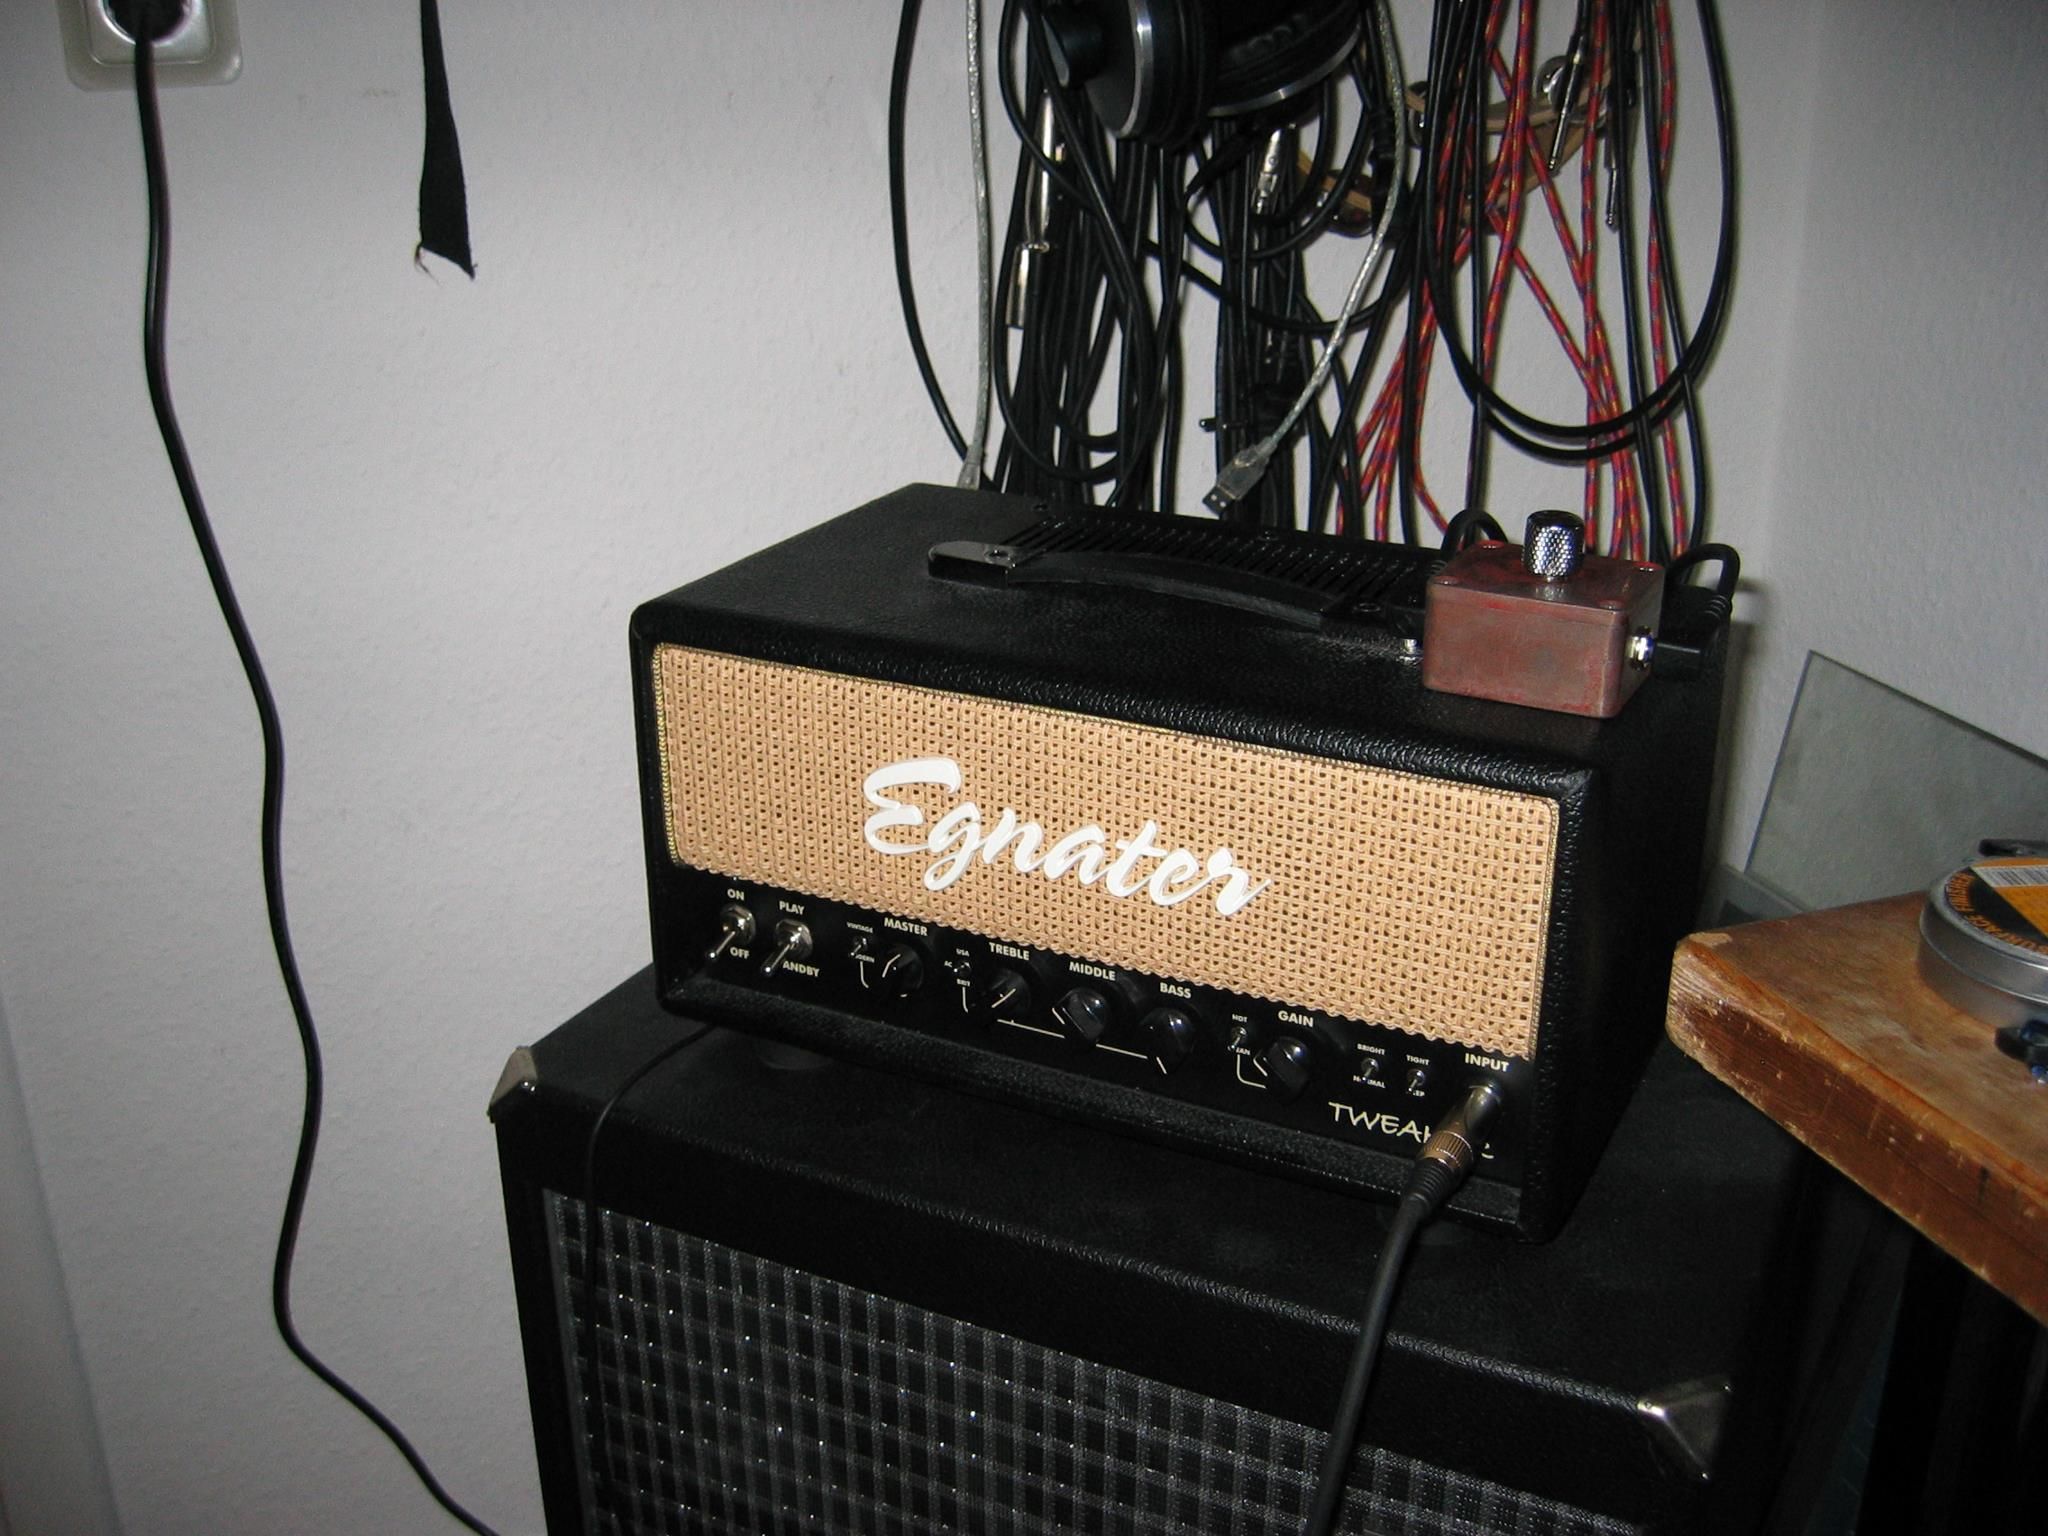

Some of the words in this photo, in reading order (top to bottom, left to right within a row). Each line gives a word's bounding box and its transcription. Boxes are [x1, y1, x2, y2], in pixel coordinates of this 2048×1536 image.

[863, 757, 1271, 916] Egnater
[727, 888, 745, 900] ON
[779, 900, 804, 915] PLAY
[884, 917, 928, 936] MASTER
[730, 946, 750, 959] OFF
[956, 948, 970, 957] USA
[989, 942, 1030, 961] TREBLE
[783, 961, 820, 977] ANDBY
[1069, 961, 1116, 981] MIDDLE
[1160, 982, 1192, 999] BASS
[1232, 1014, 1248, 1022] HOT
[1278, 1010, 1314, 1028] GAIN
[1357, 1043, 1385, 1056] BRIGHT
[1406, 1054, 1430, 1066] TIGHT
[1464, 1052, 1510, 1073] INPUT
